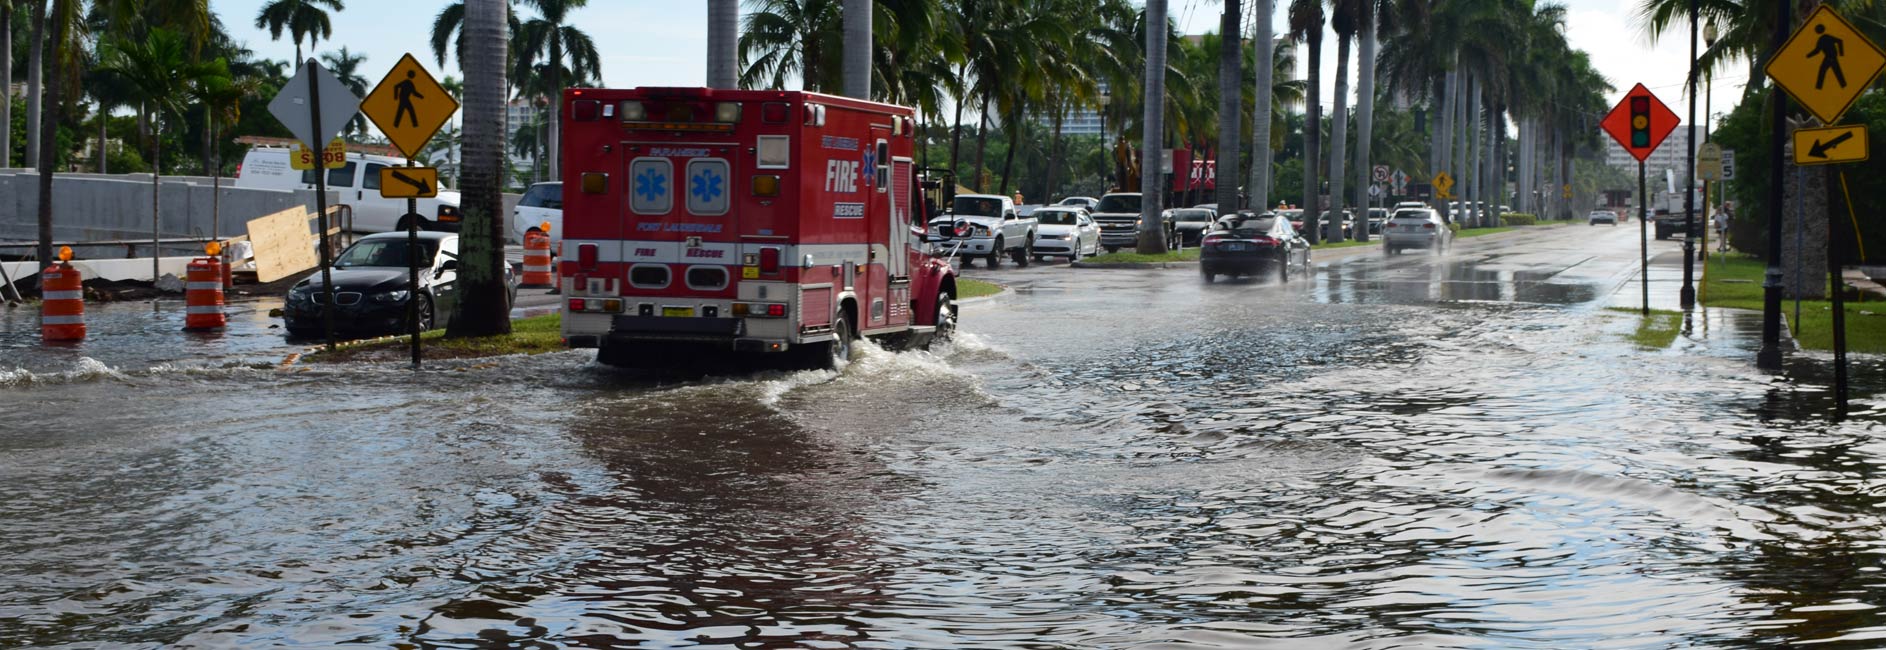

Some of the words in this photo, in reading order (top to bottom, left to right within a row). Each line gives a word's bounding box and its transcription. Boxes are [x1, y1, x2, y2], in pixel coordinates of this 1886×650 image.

[649, 147, 711, 157] PARAMEDIC
[825, 159, 859, 193] FIRE
[1723, 165, 1733, 177] 5
[834, 204, 864, 216] RESCUE
[636, 222, 661, 231] FORT
[634, 248, 657, 256] FIRE
[686, 248, 724, 258] RESCUE
